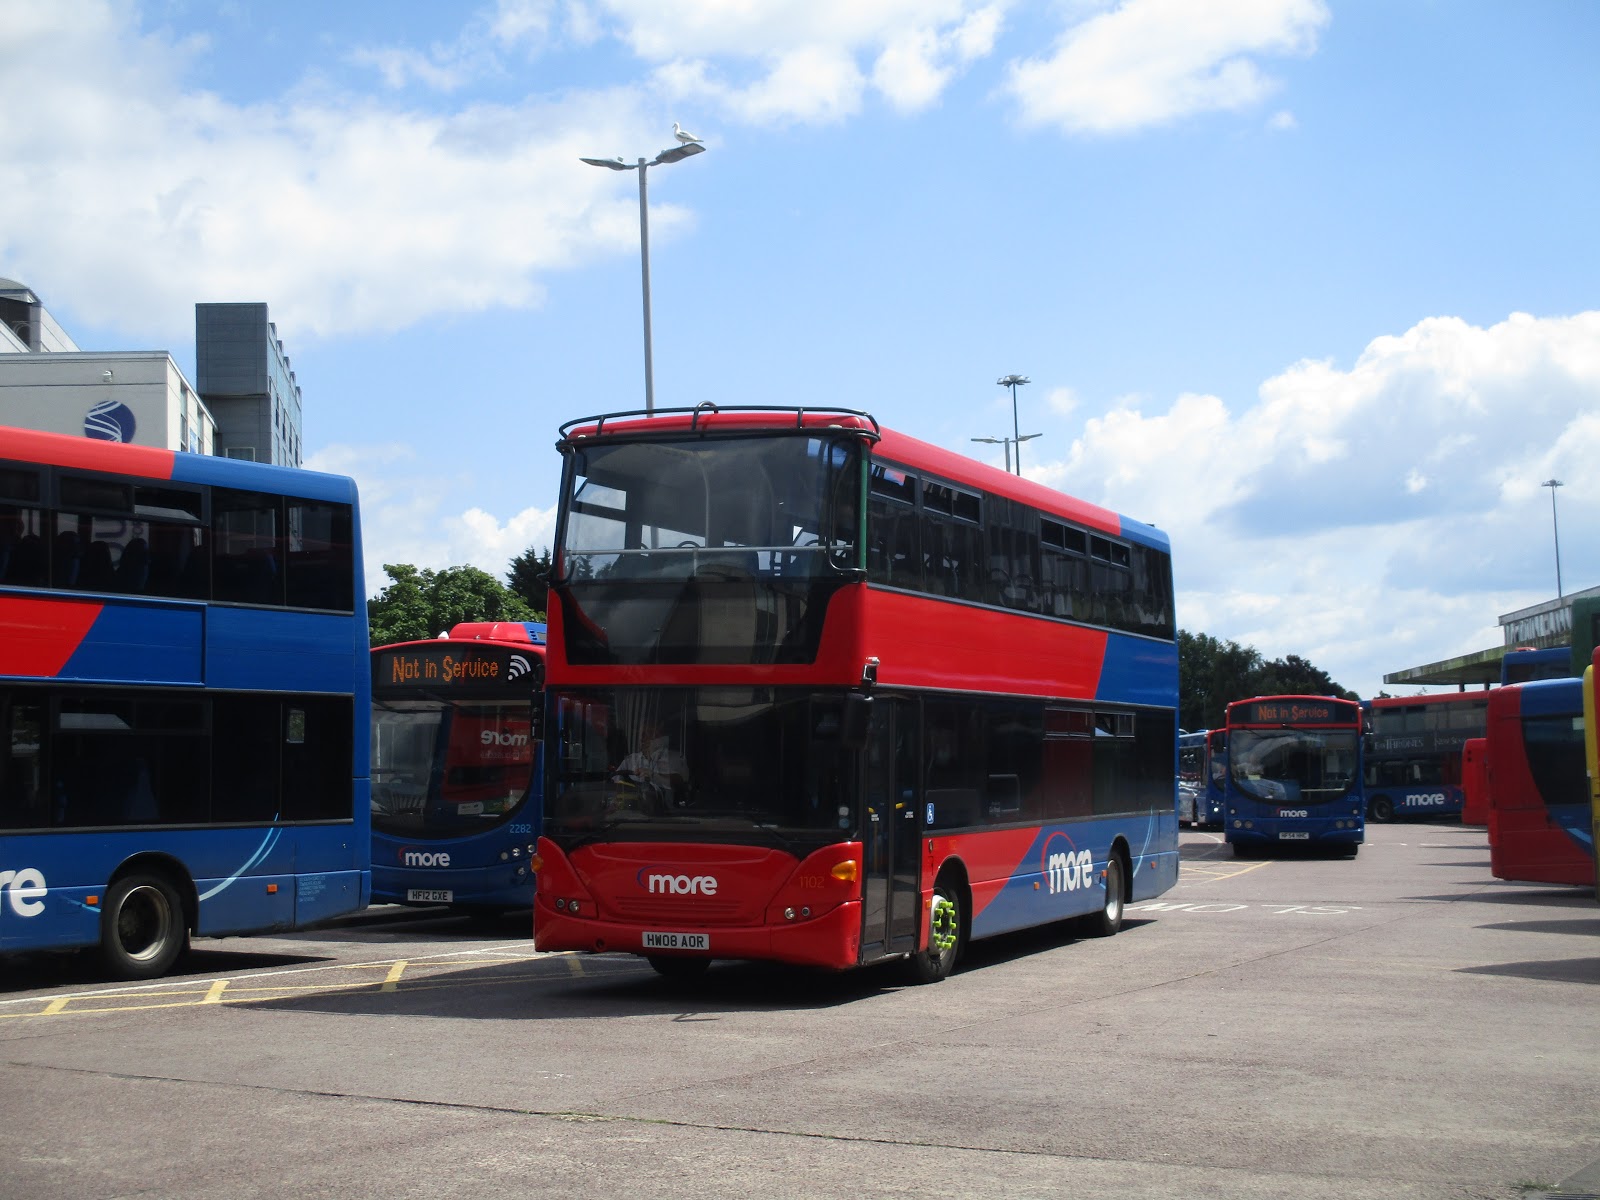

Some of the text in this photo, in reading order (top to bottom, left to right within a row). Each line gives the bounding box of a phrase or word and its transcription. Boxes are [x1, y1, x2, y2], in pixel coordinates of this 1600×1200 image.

[392, 655, 499, 683] Not in Service
[1258, 705, 1329, 721] Not in Service
[1406, 793, 1445, 807] more
[1279, 809, 1308, 818] more
[509, 824, 532, 834] 2282
[405, 852, 451, 867] more
[1049, 848, 1093, 894] more
[649, 873, 718, 896] more
[799, 875, 825, 889] 1102
[412, 890, 448, 901] HF12 GXE
[646, 934, 704, 948] HW08 AOR
